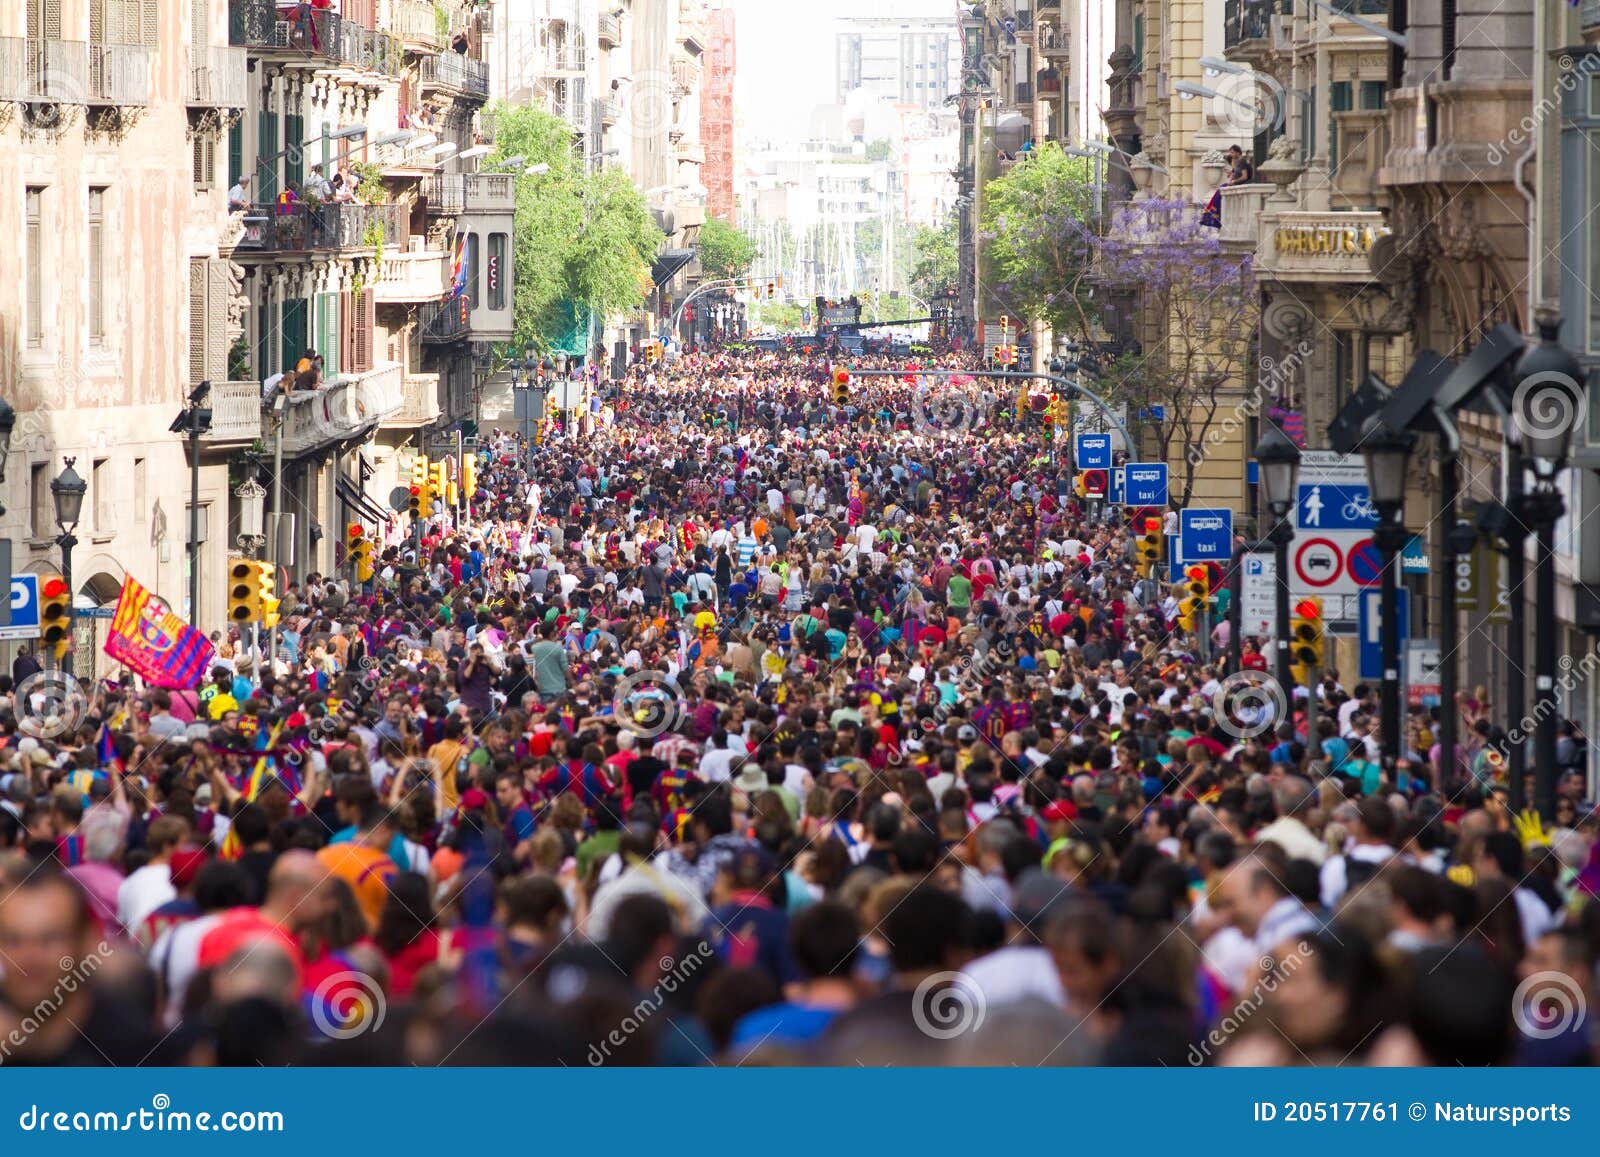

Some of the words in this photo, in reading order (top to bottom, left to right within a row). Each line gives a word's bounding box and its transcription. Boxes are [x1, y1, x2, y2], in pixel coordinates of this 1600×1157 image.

[1088, 456, 1101, 464] taxi
[1138, 491, 1155, 500] taxi
[1197, 543, 1217, 553] taxi
[986, 718, 1004, 739] 10
